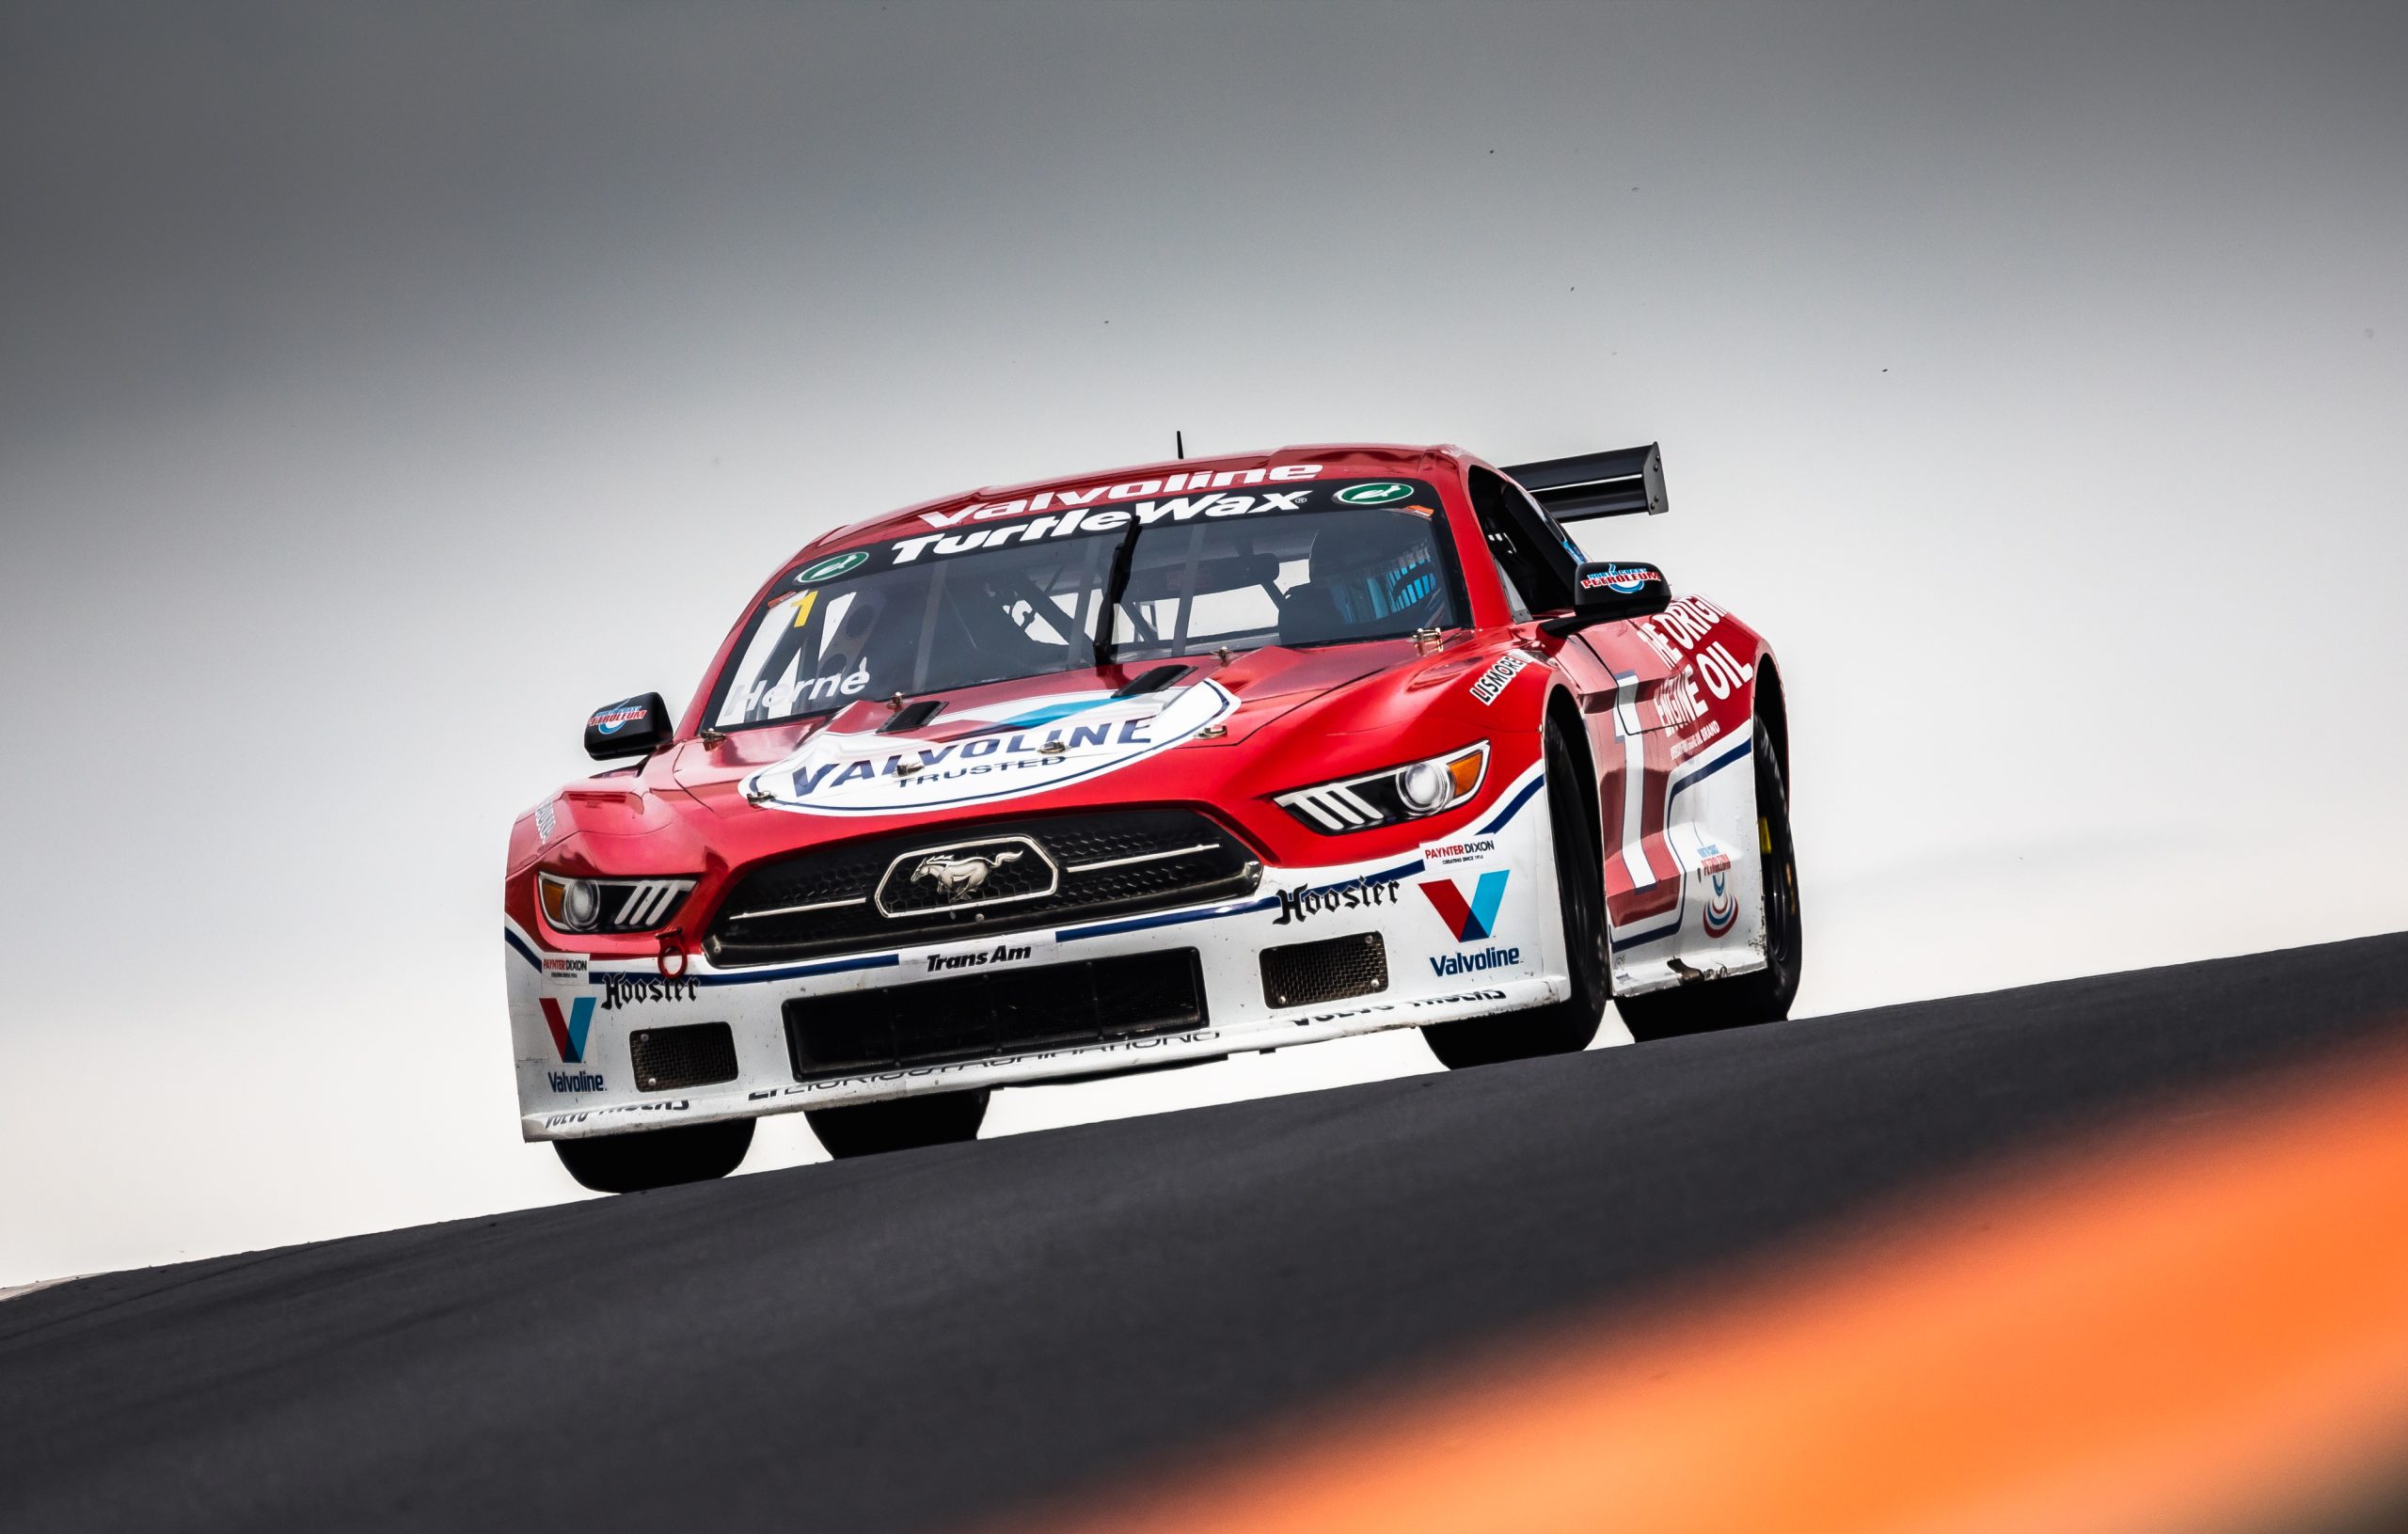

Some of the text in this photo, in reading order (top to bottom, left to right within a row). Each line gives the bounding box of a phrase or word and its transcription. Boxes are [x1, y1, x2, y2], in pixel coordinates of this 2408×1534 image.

[918, 462, 1324, 532] Valvoline
[1581, 572, 1661, 589] PETROLEUM
[790, 589, 819, 628] 1
[1470, 655, 1525, 704] LISMORE
[1696, 640, 1754, 701] OIL
[791, 716, 1156, 799] VALVOLINE
[895, 754, 1067, 788] TRUSTED
[1425, 840, 1495, 860] PAYNTER DIXON
[1272, 874, 1401, 925] Hoosier
[543, 958, 587, 971] PAYNTER DIXON
[927, 945, 1032, 973] Trans Am
[1429, 946, 1520, 977] Valvoline
[600, 971, 701, 1011] Hoosier
[547, 1070, 604, 1093] Valvoline
